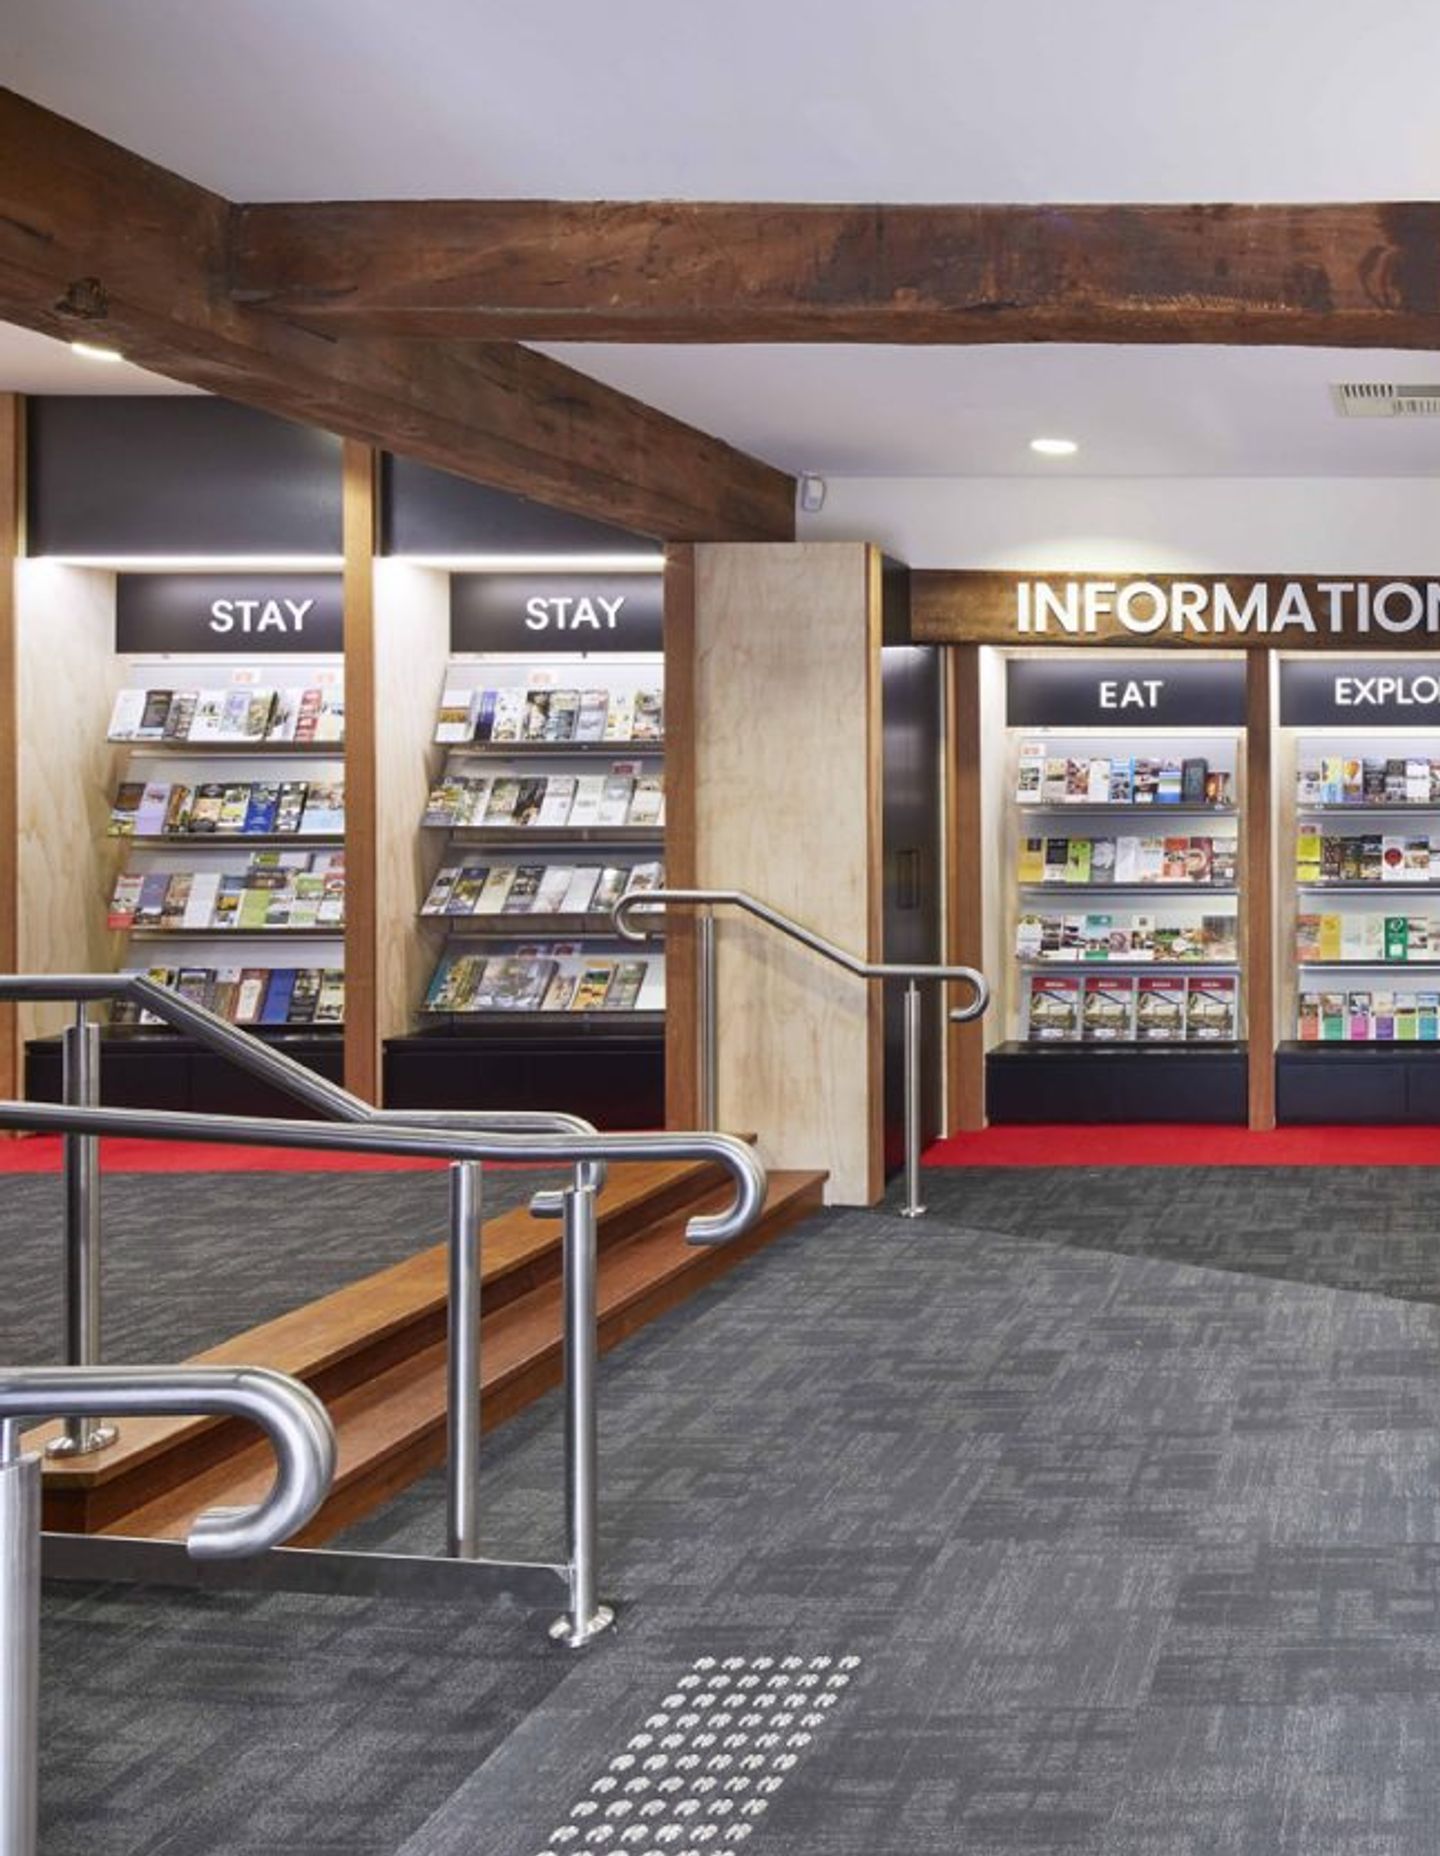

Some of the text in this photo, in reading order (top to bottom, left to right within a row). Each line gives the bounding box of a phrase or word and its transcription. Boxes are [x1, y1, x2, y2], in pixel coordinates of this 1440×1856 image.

[208, 598, 314, 632] STAY
[525, 596, 626, 630] STAY
[1099, 680, 1164, 708] EAT
